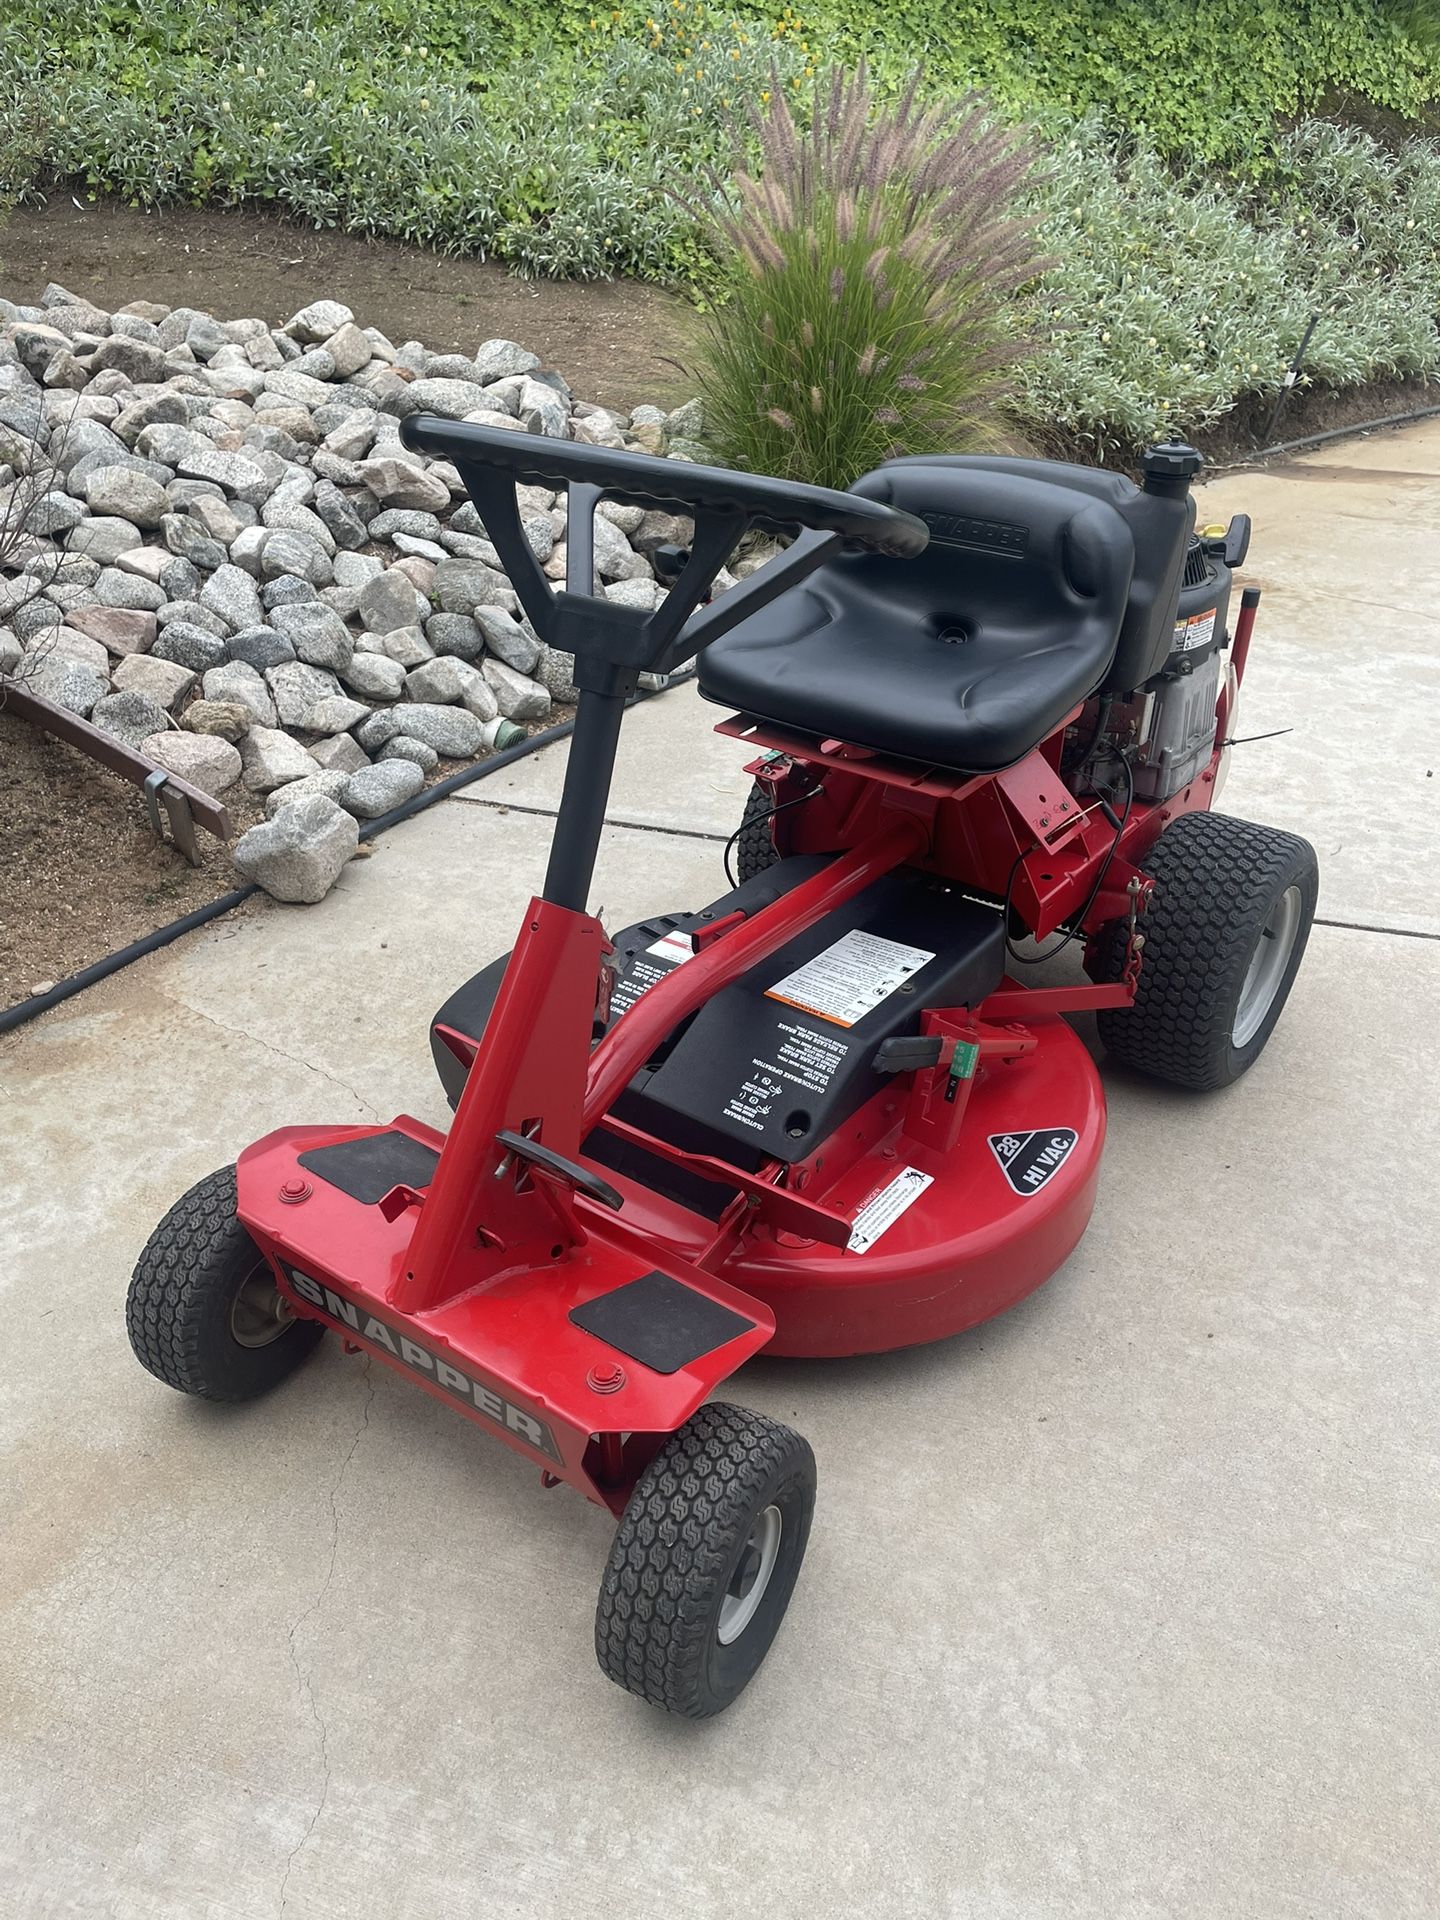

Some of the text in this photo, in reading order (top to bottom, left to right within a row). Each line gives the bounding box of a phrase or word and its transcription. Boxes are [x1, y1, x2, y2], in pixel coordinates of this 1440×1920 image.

[777, 1023, 798, 1034] BRAKE
[797, 1031, 814, 1041] PARK
[779, 1046, 800, 1059] BRAKE
[812, 1038, 839, 1052] RELEASE
[798, 1055, 816, 1065] PARK
[814, 1062, 827, 1070] SET
[752, 1058, 826, 1094] CLUTCH/BRAKE OPERATION
[803, 1071, 829, 1086] TO STOP
[722, 1108, 765, 1131] CLUTCH/BRAKE
[996, 1135, 1020, 1157] 28
[1022, 1164, 1047, 1186] HI
[859, 1186, 883, 1210] DANGER
[291, 1270, 542, 1446] SNAPPER
